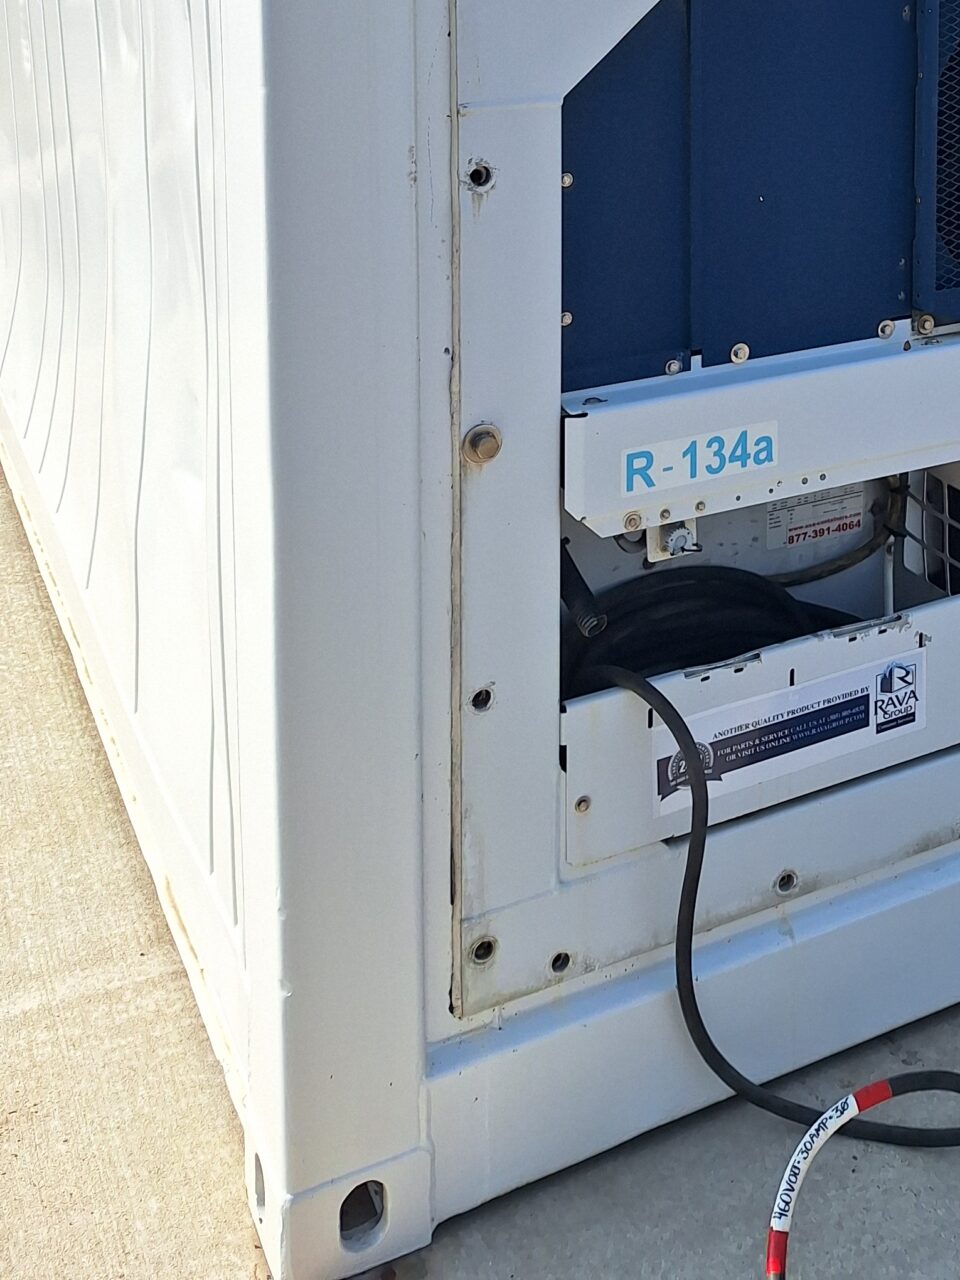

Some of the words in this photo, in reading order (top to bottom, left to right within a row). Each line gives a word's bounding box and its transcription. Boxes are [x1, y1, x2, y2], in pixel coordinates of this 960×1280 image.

[788, 520, 861, 544] 877-391-4064
[712, 722, 750, 740] ANOTHER
[751, 711, 785, 728] QUALITY
[786, 700, 822, 716] PRODUCT
[822, 690, 859, 706] PROVIDED
[860, 685, 870, 694] BY
[874, 690, 920, 716] RAVA
[882, 704, 912, 720] Group
[718, 747, 731, 756] FOR
[732, 740, 754, 752] PARTS
[761, 728, 790, 743] SERVICE
[726, 754, 736, 762] OR
[738, 748, 755, 758] VISIT
[766, 735, 792, 749] ONLINE
